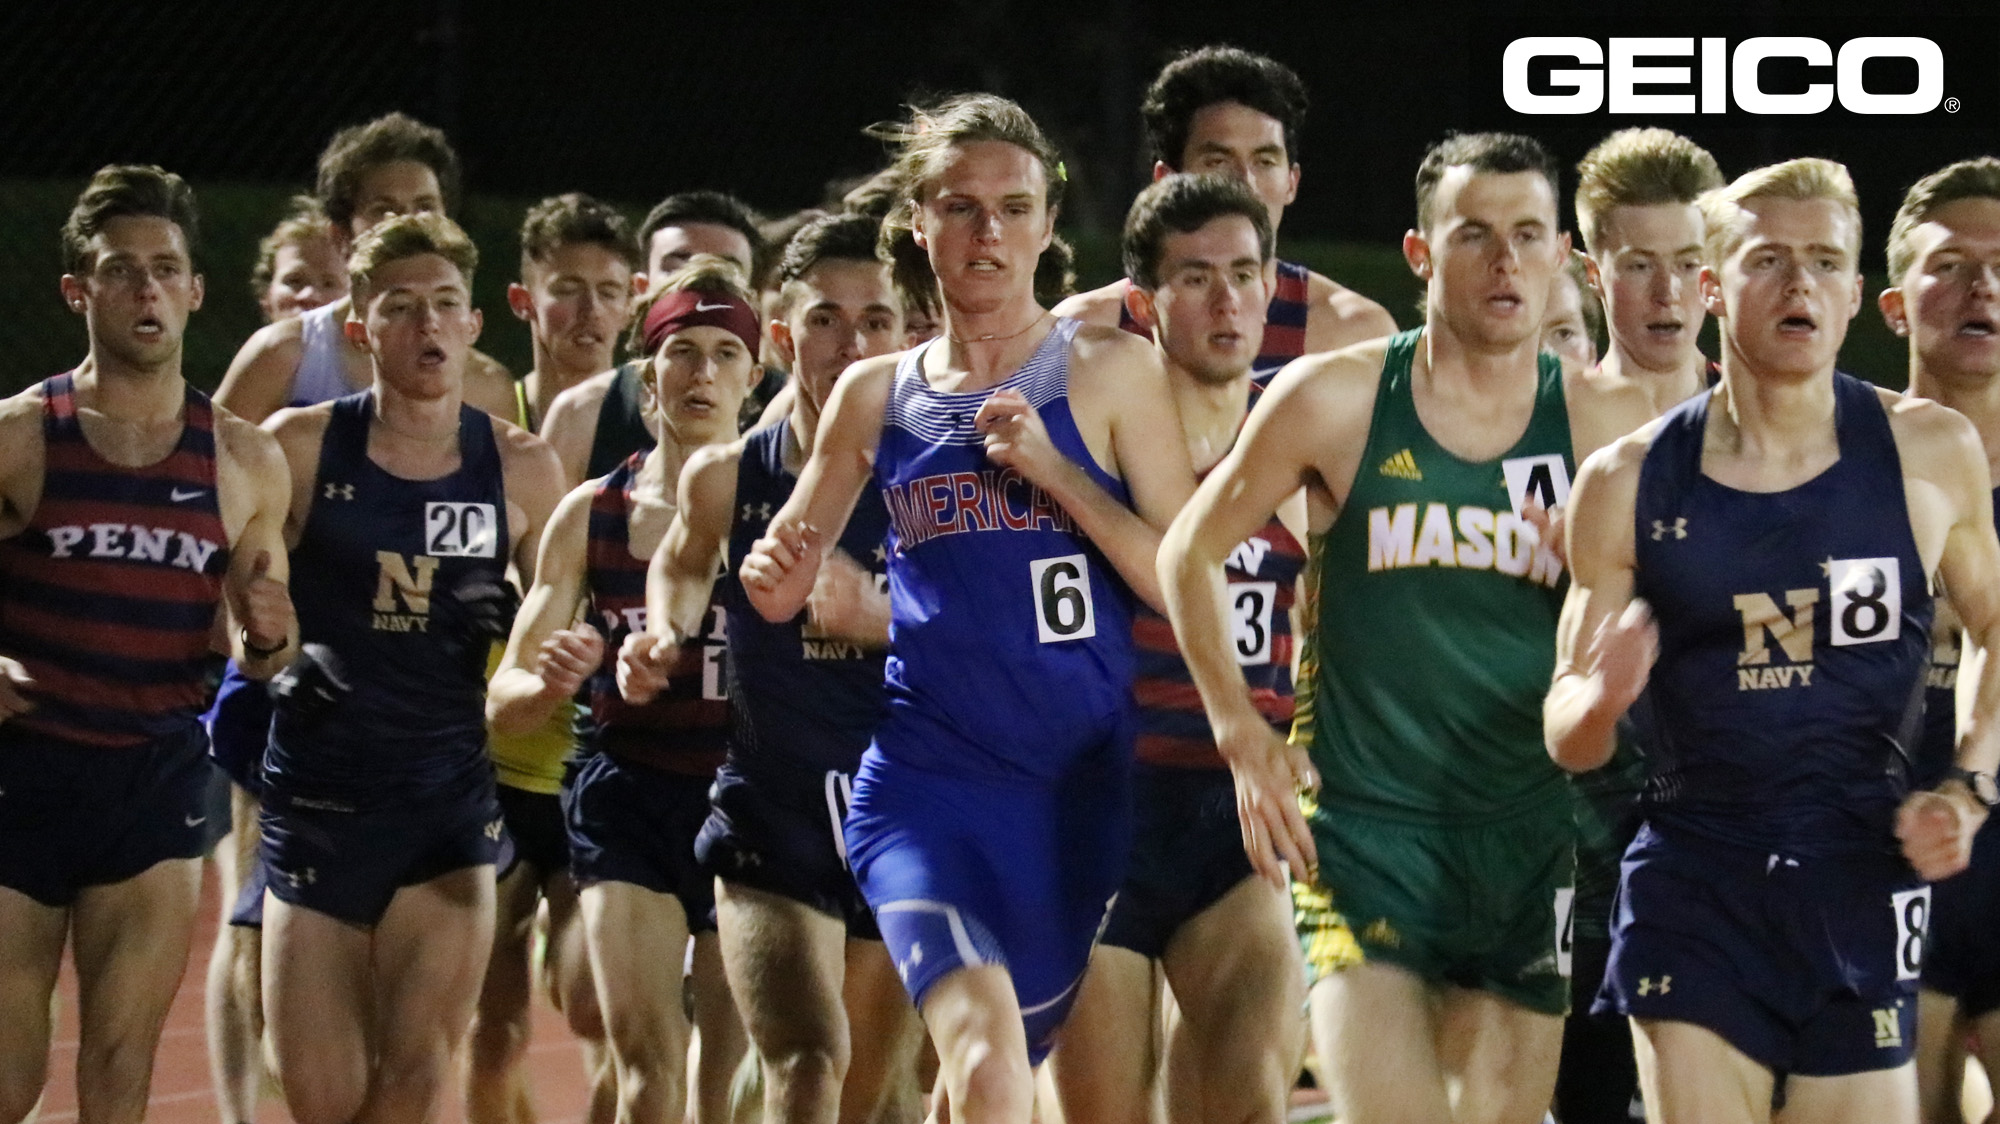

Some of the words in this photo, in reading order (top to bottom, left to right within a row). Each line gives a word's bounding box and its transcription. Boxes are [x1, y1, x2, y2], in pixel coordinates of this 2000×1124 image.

[430, 505, 485, 554] 20
[882, 467, 1089, 550] AMERICA
[46, 523, 219, 573] PENN
[375, 550, 440, 614] N
[1041, 562, 1086, 635] 6
[1841, 565, 1890, 639] 8
[372, 612, 430, 633] NAVY
[1235, 590, 1265, 657] 3
[1733, 588, 1820, 666] N
[1737, 664, 1815, 691] NAVY
[1903, 896, 1926, 973] 8
